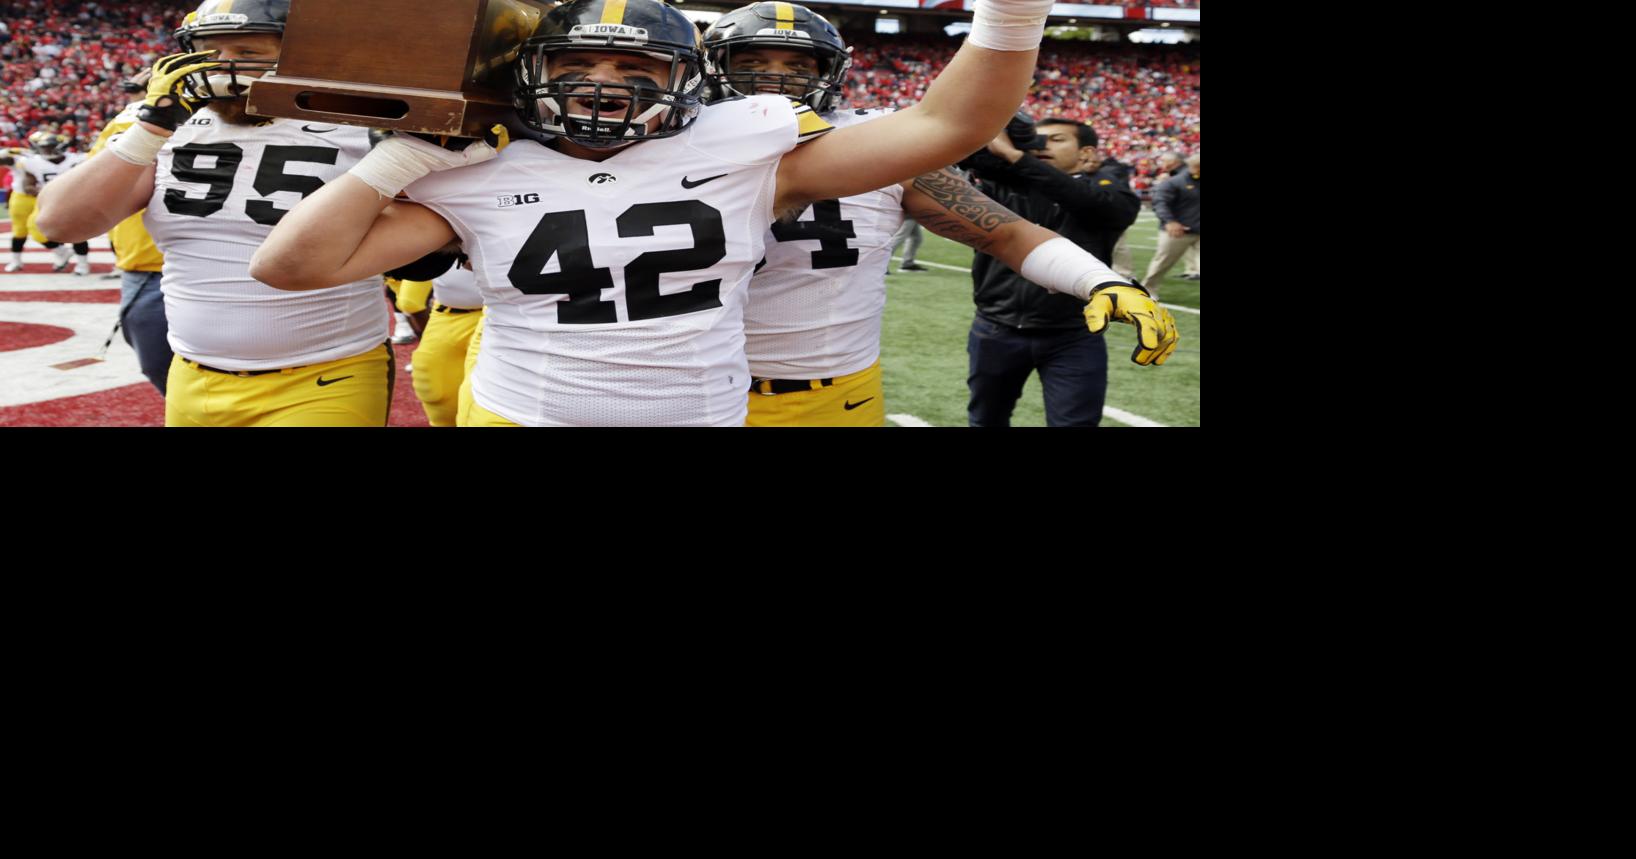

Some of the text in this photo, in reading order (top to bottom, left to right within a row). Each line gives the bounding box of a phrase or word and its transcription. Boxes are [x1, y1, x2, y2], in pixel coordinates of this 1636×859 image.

[594, 25, 626, 34] IOWA
[774, 29, 798, 37] IOWA
[581, 125, 611, 133] Riell
[163, 142, 340, 226] 95
[506, 199, 727, 324] 42
